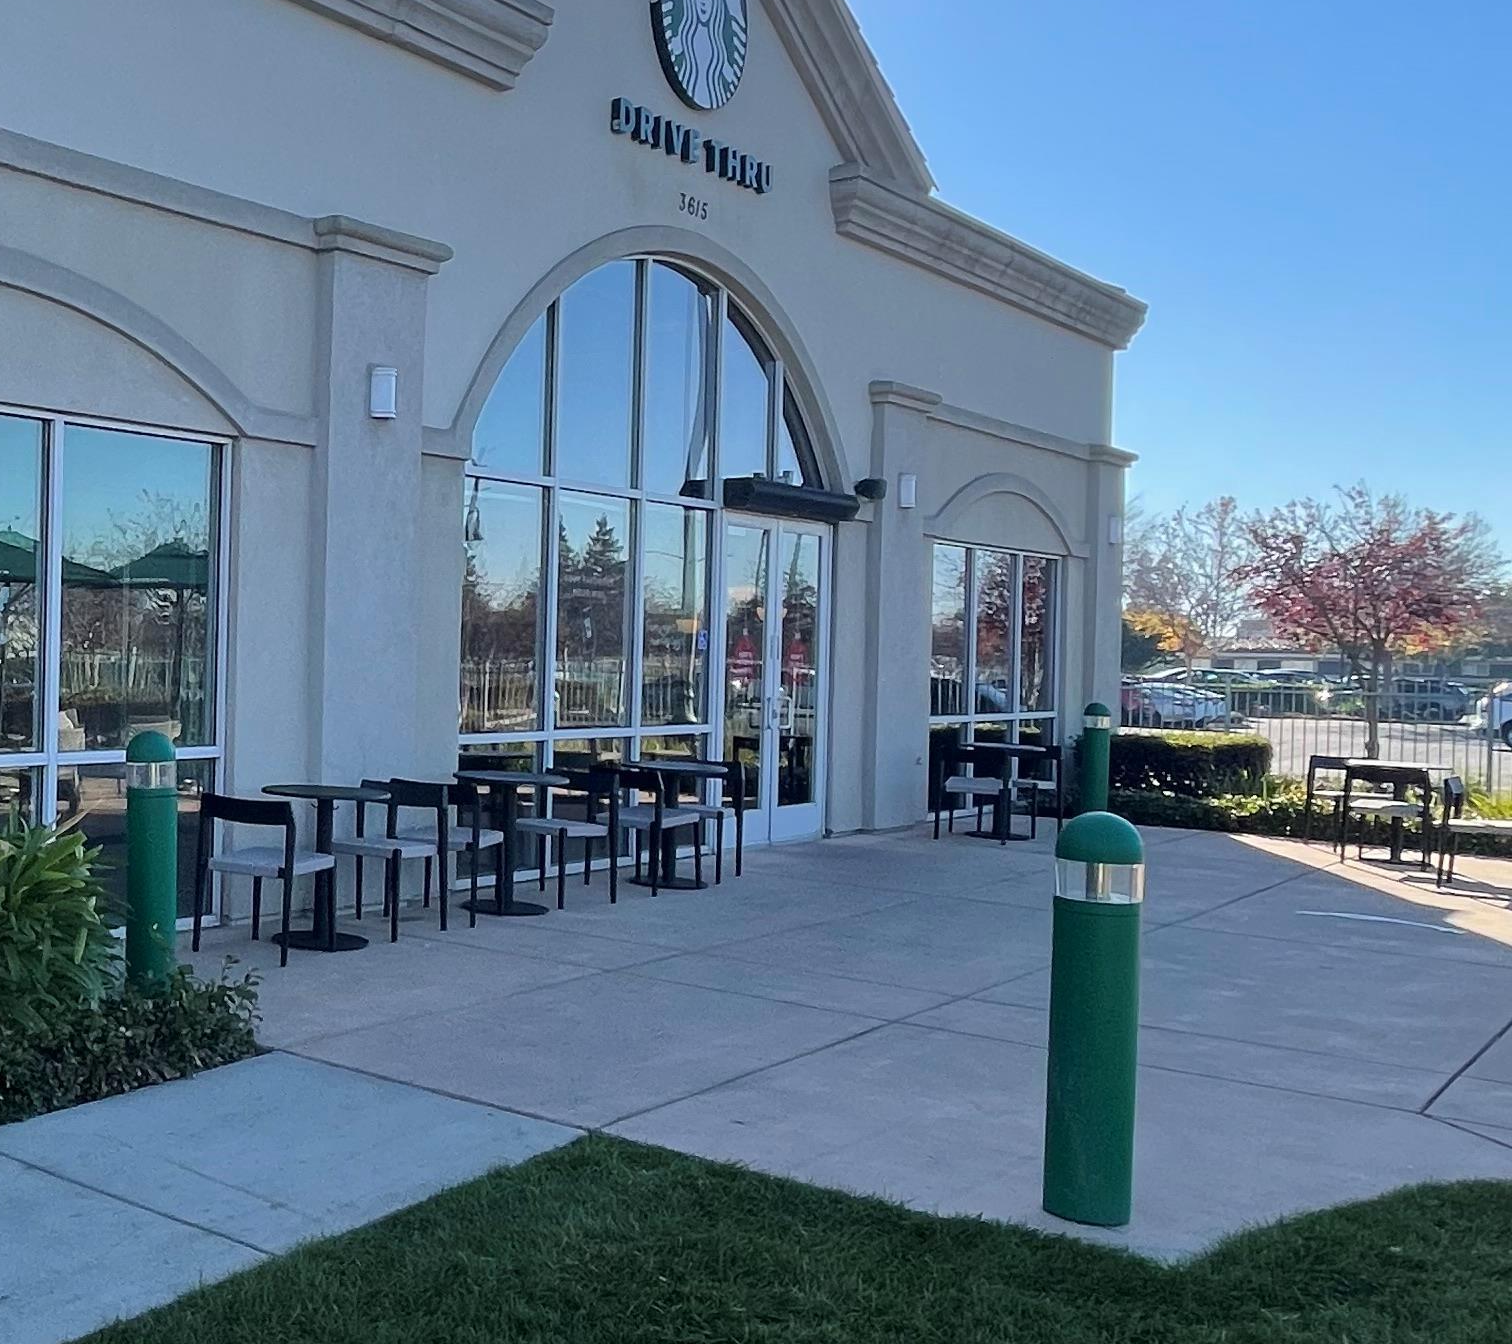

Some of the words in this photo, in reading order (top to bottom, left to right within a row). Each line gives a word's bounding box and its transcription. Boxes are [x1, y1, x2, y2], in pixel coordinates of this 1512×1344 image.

[611, 96, 701, 163] DRIVE
[703, 137, 774, 193] THRU
[679, 192, 709, 220] 3615
